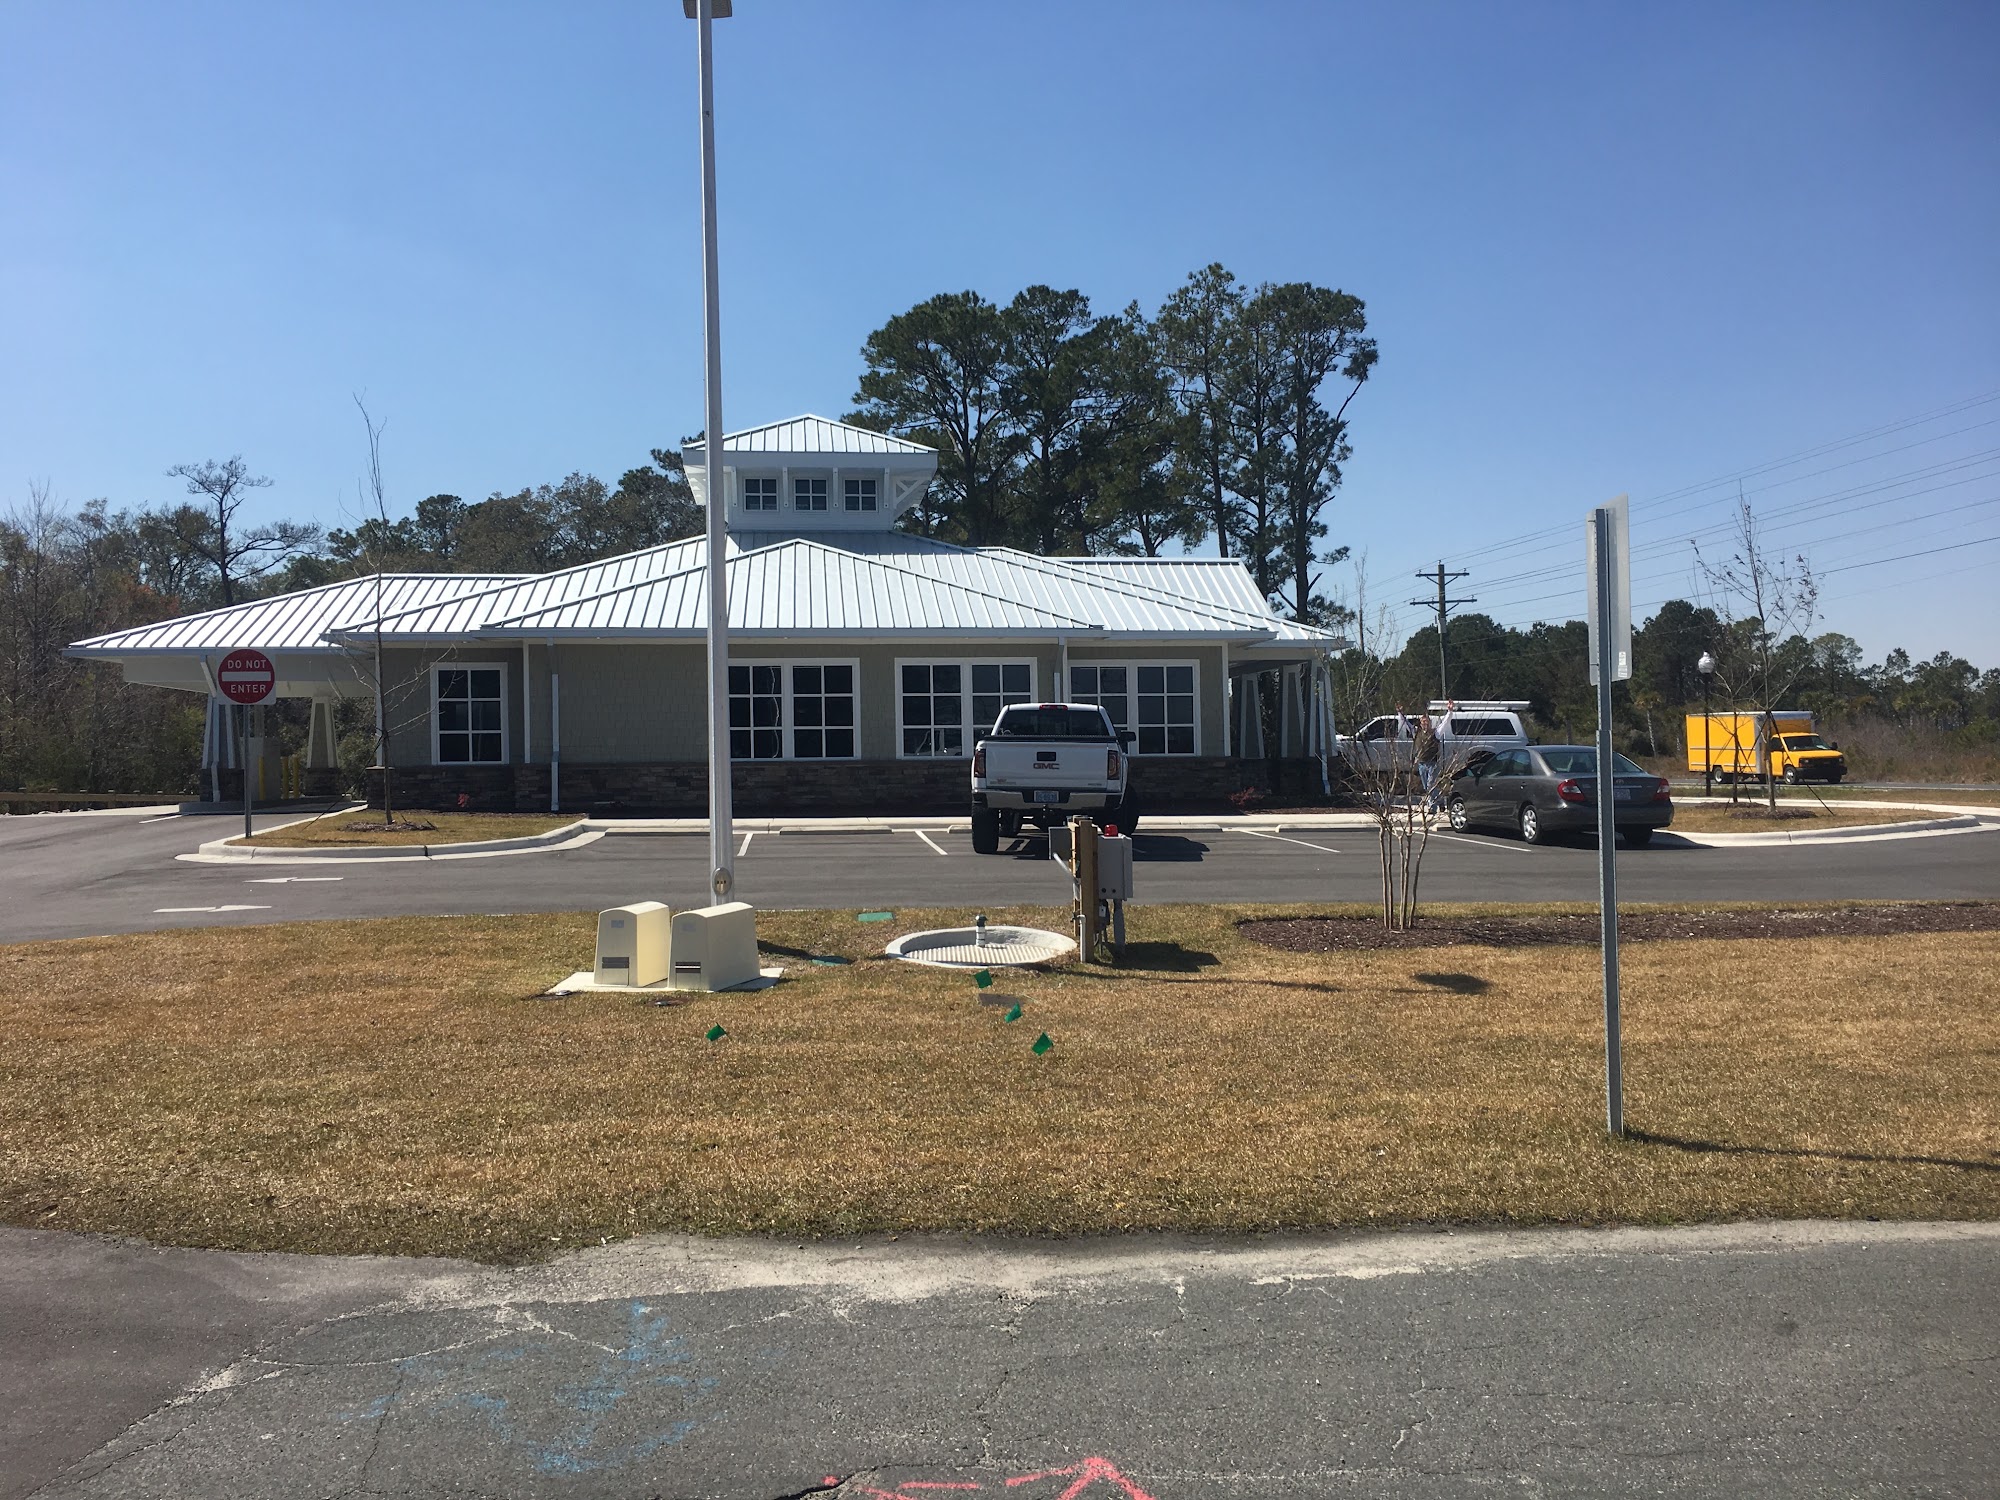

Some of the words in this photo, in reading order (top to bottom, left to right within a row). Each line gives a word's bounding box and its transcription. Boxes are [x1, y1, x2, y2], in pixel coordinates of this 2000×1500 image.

[227, 660, 242, 669] DO
[245, 660, 267, 669] NOT
[230, 684, 266, 693] ENTER
